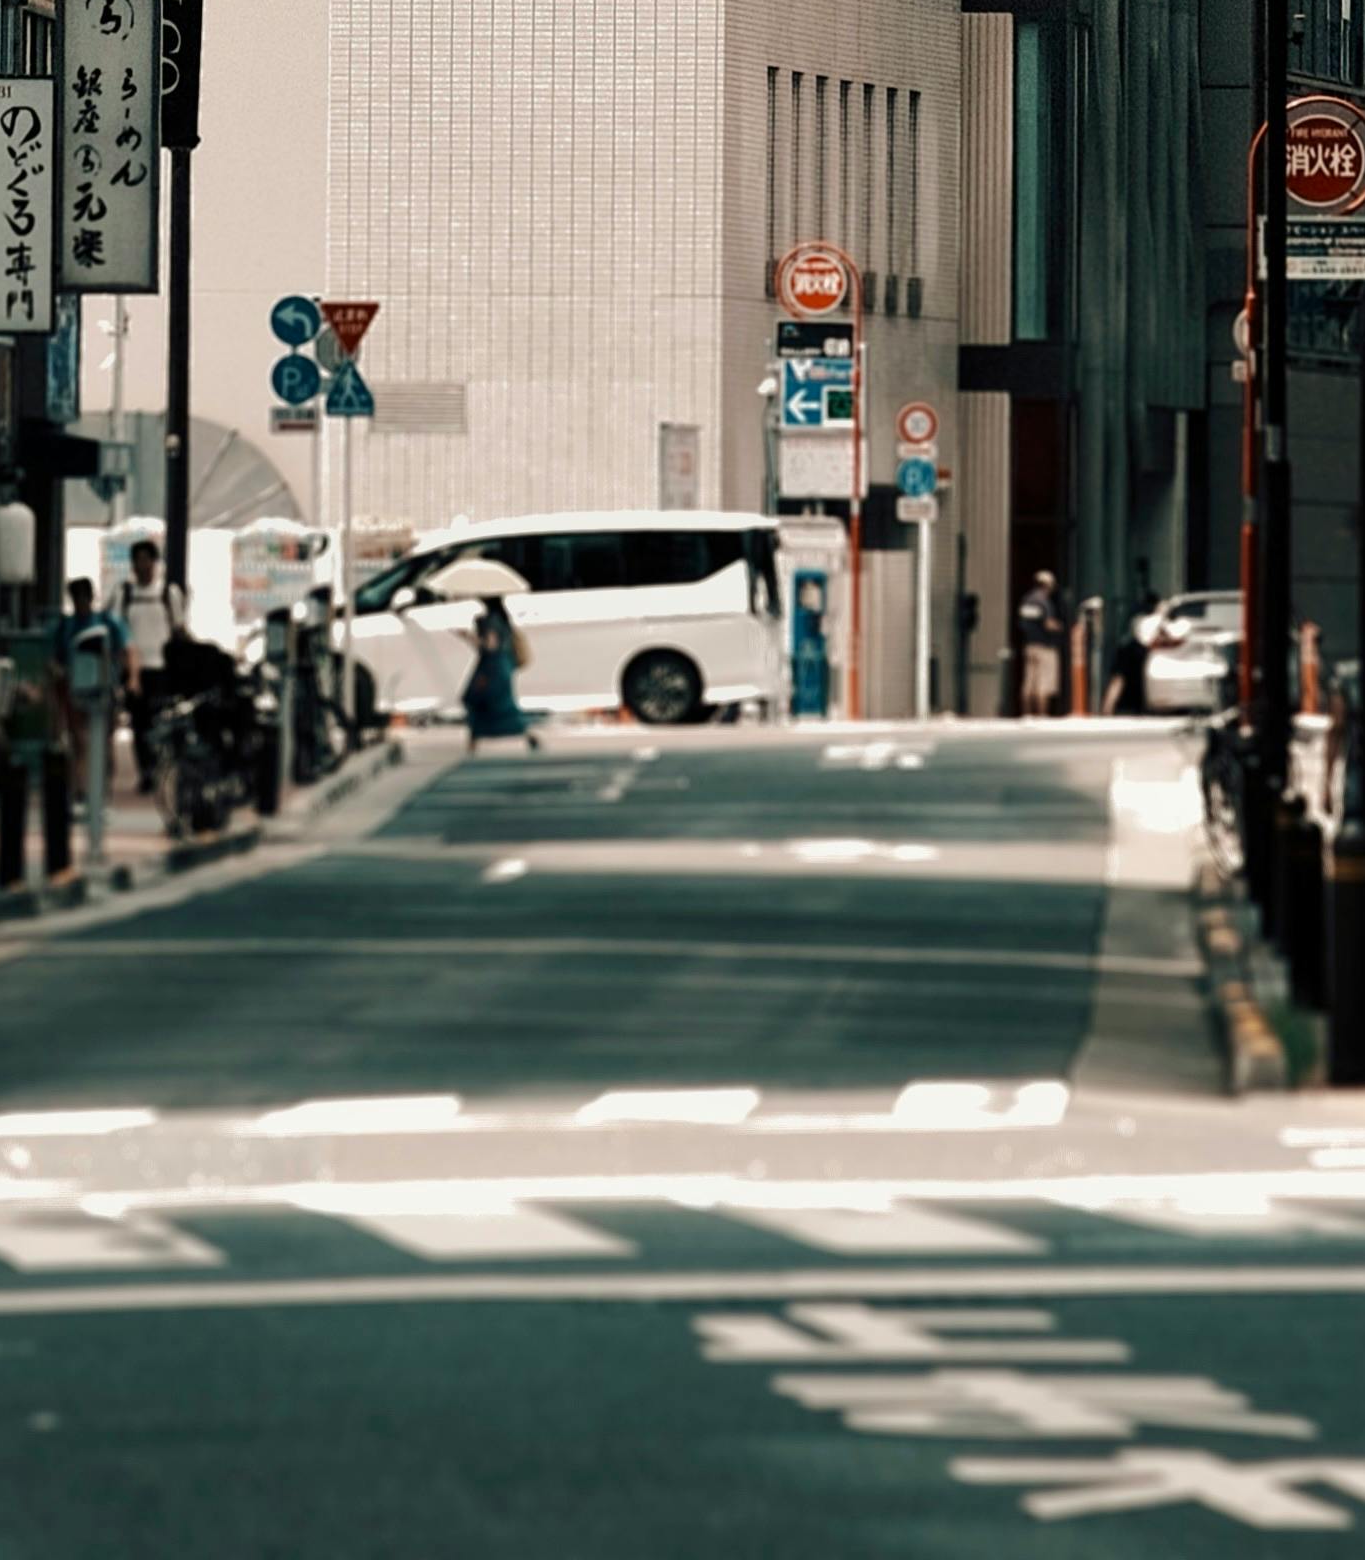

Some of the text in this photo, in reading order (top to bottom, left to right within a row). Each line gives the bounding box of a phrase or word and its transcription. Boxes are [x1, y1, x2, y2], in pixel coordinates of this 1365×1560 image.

[110, 67, 148, 188] らーめん
[1286, 143, 1357, 178] 消火栓
